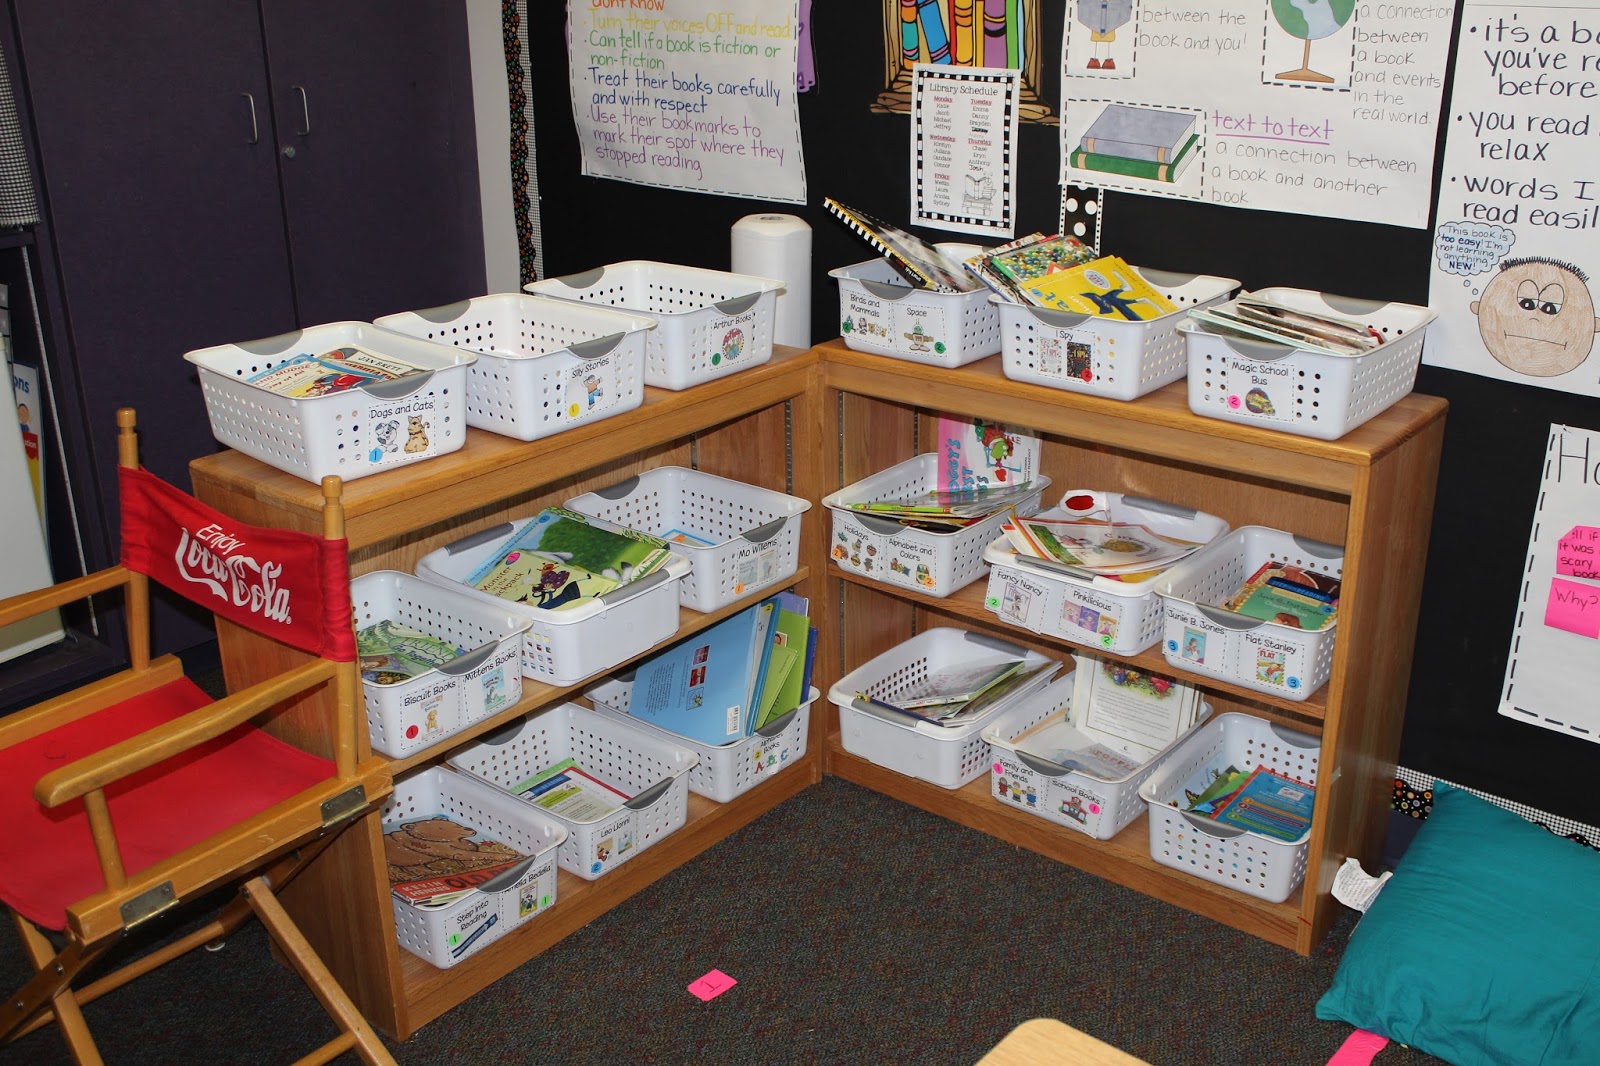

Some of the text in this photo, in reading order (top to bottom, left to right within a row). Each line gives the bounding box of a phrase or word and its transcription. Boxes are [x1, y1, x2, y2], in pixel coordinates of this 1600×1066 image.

[1142, 7, 1246, 26] between the
[1360, 2, 1453, 20] a connection
[587, 8, 790, 38] Turn their voices OFF and read
[1485, 13, 1560, 43] it's a
[589, 28, 781, 57] Can tell if book is fiction or
[1139, 32, 1247, 55] book and you!
[1358, 29, 1429, 44] between
[591, 48, 664, 69] non-fiction
[1357, 49, 1415, 65] a book
[1484, 48, 1567, 77] you've
[588, 67, 781, 106] Treat their books carefully
[1354, 70, 1441, 89] and events
[1498, 73, 1598, 98] before
[929, 83, 998, 96] Library Schedule
[1354, 88, 1405, 106] in the
[592, 90, 707, 113] and with respect
[934, 96, 953, 104] Monday
[971, 98, 992, 106] Tuesday
[590, 105, 761, 138] Use their bookmarks to
[1212, 110, 1334, 139] text to text
[1353, 107, 1431, 125] real world.
[1469, 111, 1590, 137] you read
[594, 124, 784, 167] mark their spot where they
[968, 138, 992, 146] Thursday
[1480, 139, 1550, 161] relax
[596, 146, 702, 181] stopped reading
[1216, 140, 1417, 173] a connection between
[1211, 165, 1388, 197] a book and another
[1464, 175, 1595, 201] words I
[1212, 185, 1248, 204] book
[1463, 202, 1519, 225] read
[1440, 234, 1455, 243] too
[1485, 240, 1503, 250] I'm
[1445, 225, 1508, 241] This book is
[1440, 244, 1495, 260] not learning
[1443, 252, 1489, 267] anything
[1449, 261, 1476, 271] NEW!
[850, 293, 880, 308] Birds and
[850, 304, 880, 318] Mammals
[906, 307, 928, 317] Space
[713, 314, 752, 330] Arthur Books
[1059, 330, 1074, 341] Spy
[358, 356, 375, 366] JAN
[376, 358, 403, 373] BRETT
[584, 358, 610, 373] Stories
[1231, 361, 1289, 377] Magic School
[1251, 375, 1268, 386] Bus
[370, 401, 434, 419] Dogs and Cats
[196, 523, 246, 555] Enjoy
[844, 524, 869, 542] Holidays
[1589, 530, 1598, 541] if
[738, 537, 778, 559] Mo Willems
[888, 537, 933, 556] Alphabet and
[899, 549, 921, 562] Colors
[1559, 541, 1595, 554] it was
[1560, 556, 1593, 570] scary
[481, 566, 512, 592] Monster
[1573, 568, 1600, 579] book
[495, 572, 524, 597] ackpack
[997, 570, 1043, 597] Fancy Nancy
[1073, 589, 1112, 612] Pinkilicious
[1555, 586, 1599, 611] Why?
[1167, 609, 1225, 635] Junie B. Jones
[1245, 633, 1297, 655] Flat Stanley
[464, 663, 494, 683] Mittens
[495, 650, 517, 667] Books
[404, 688, 432, 707] Biscuit
[433, 681, 456, 696] Books
[763, 741, 780, 754] Books
[1000, 759, 1034, 777] Family and
[1004, 769, 1029, 784] Friends
[1052, 779, 1101, 805] School Books
[600, 826, 613, 838] Leo
[402, 881, 443, 892] KEVIN
[409, 886, 450, 897] HENKES
[457, 908, 474, 925] Step
[460, 911, 488, 932] Reading
